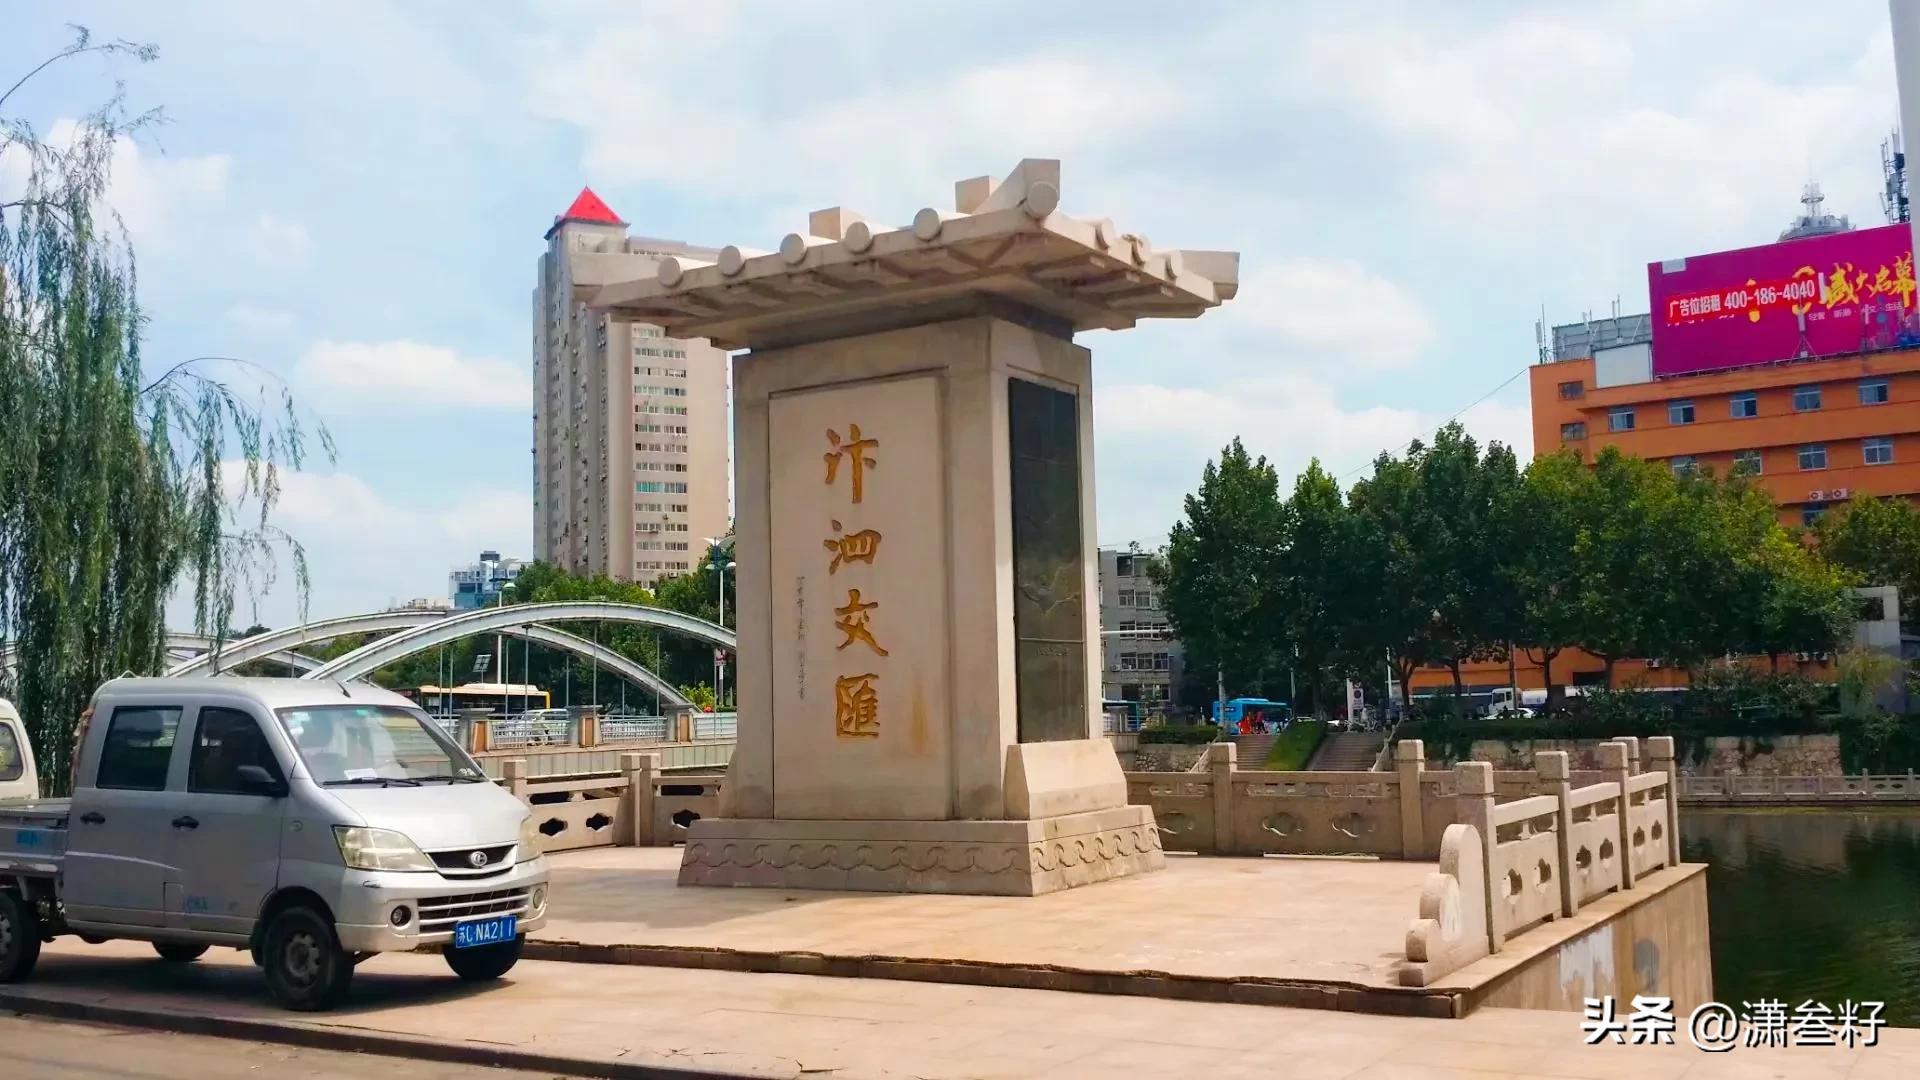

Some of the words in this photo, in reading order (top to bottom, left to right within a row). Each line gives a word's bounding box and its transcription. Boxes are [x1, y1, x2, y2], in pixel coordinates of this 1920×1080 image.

[1668, 294, 1721, 319] 广告位招租
[1724, 279, 1816, 311] 400-186-4040
